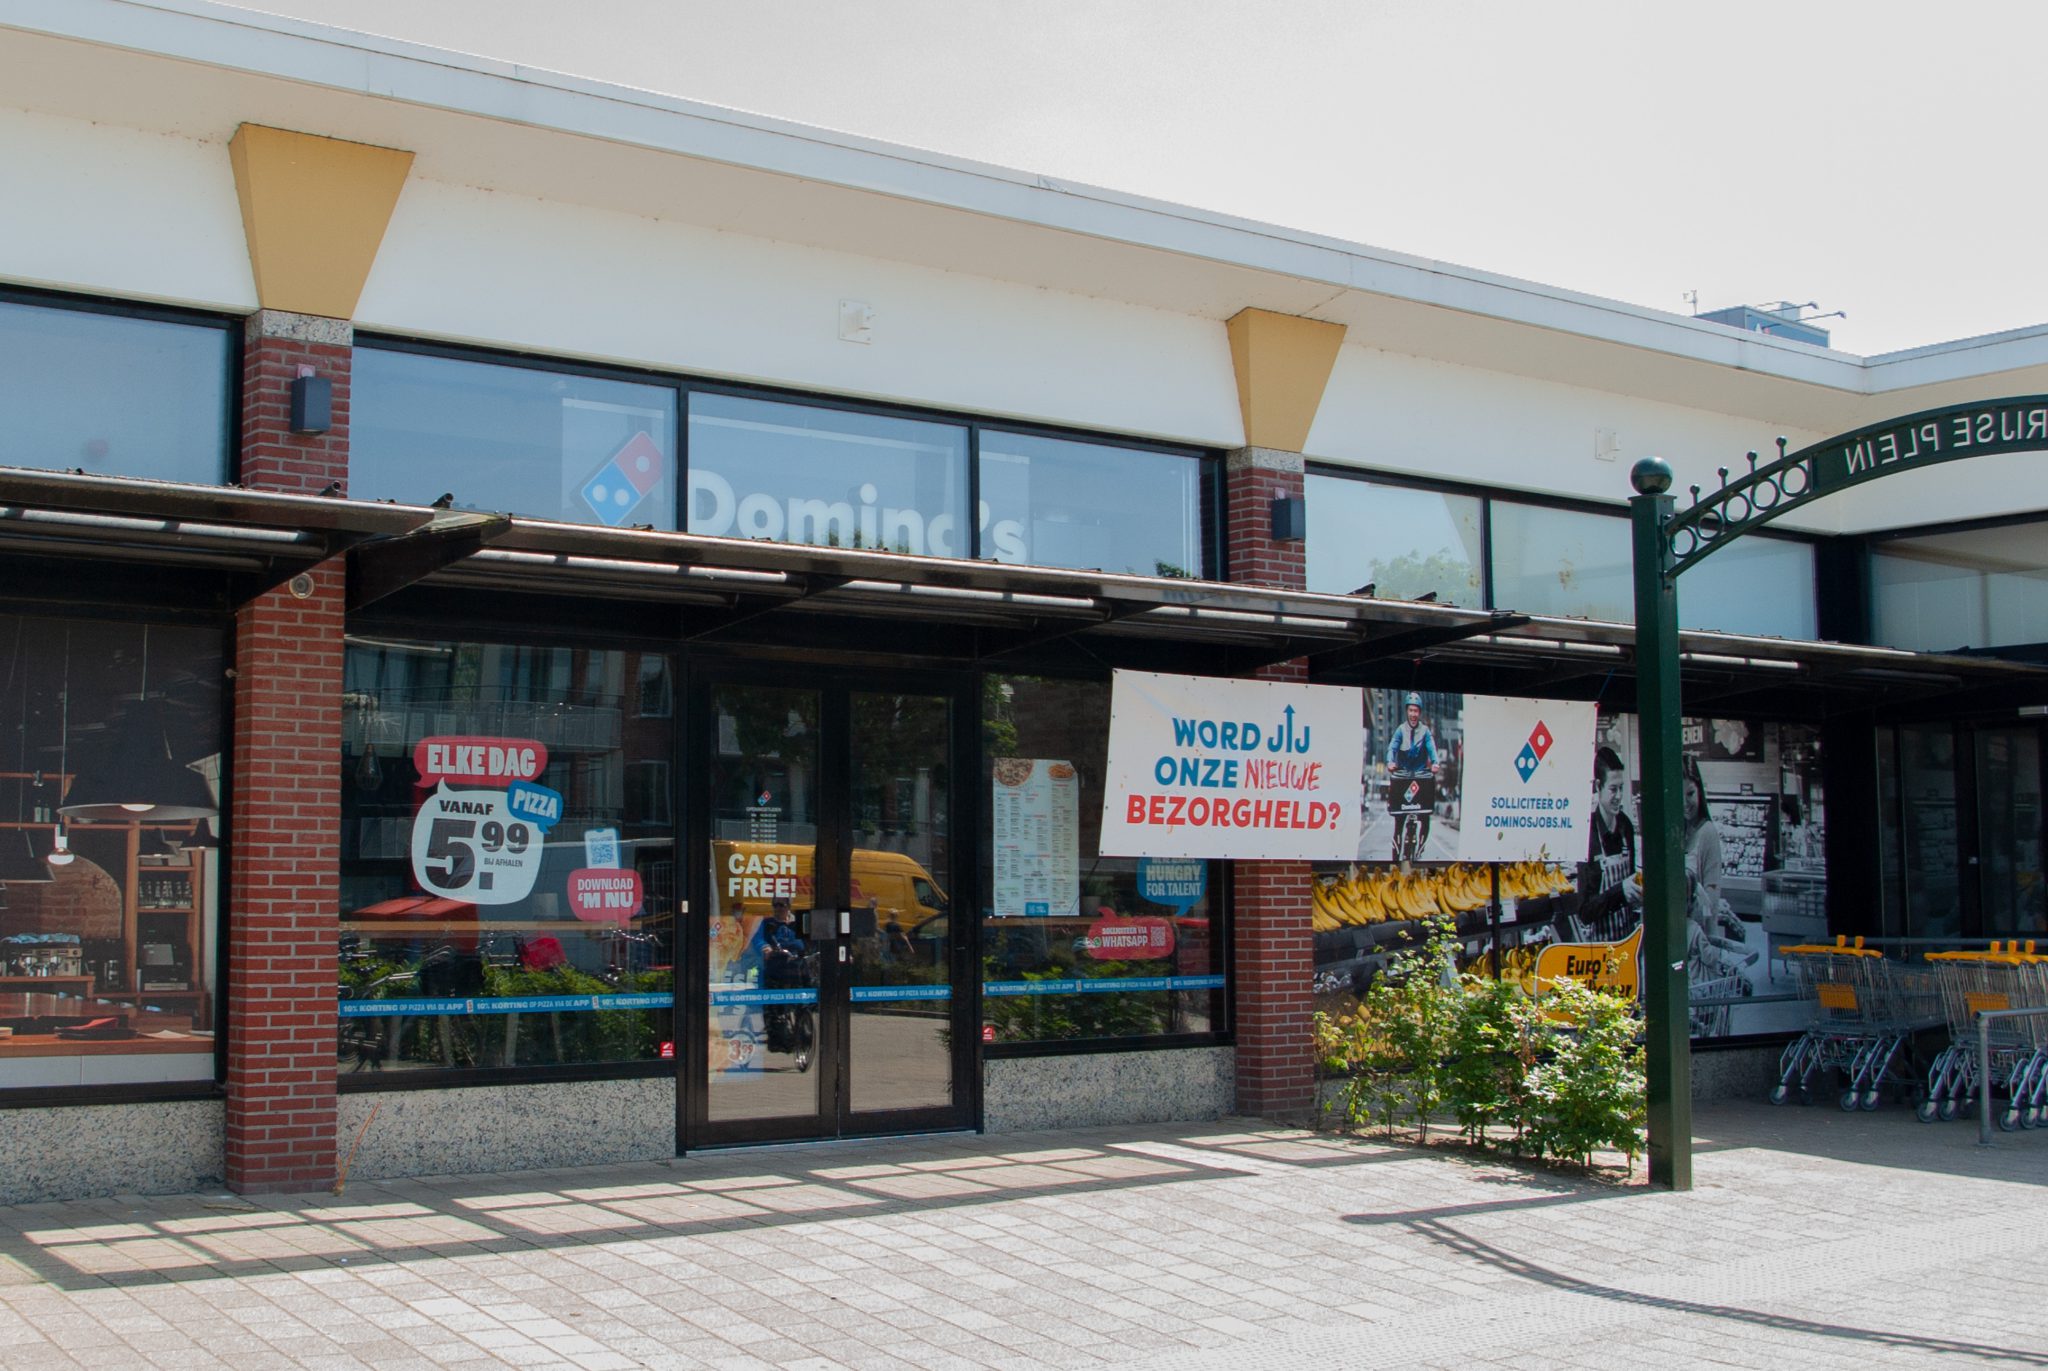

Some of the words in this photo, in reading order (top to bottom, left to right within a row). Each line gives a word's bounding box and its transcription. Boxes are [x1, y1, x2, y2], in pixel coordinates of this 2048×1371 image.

[1172, 717, 1261, 751] WORD
[1267, 706, 1310, 753] JIJ
[427, 744, 485, 775] ELKE
[489, 746, 537, 777] DAG
[1154, 756, 1238, 788] ONZE
[1244, 758, 1323, 792] NIEUWE
[439, 800, 494, 816] VANAF
[512, 788, 557, 819] PIZZA
[1491, 796, 1554, 810] SOLLICITEER
[1556, 797, 1569, 810] OP
[1126, 794, 1341, 830] BEZORGHELD?
[1485, 815, 1572, 829] DOMINOSJOBS.NL
[484, 857, 494, 866] BIJ
[495, 858, 523, 868] AFHALEN
[728, 853, 797, 875] CASH
[1146, 864, 1202, 881] HUNGRY
[577, 878, 634, 891] DOWNLOAD
[728, 878, 797, 898] FREE!
[1146, 882, 1165, 896] FOR
[1167, 882, 1202, 896] TALENT
[605, 892, 634, 908] NU
[1102, 935, 1148, 948] WHATSAPP
[360, 1004, 398, 1012] KORTING
[492, 1001, 528, 1009] KORTING
